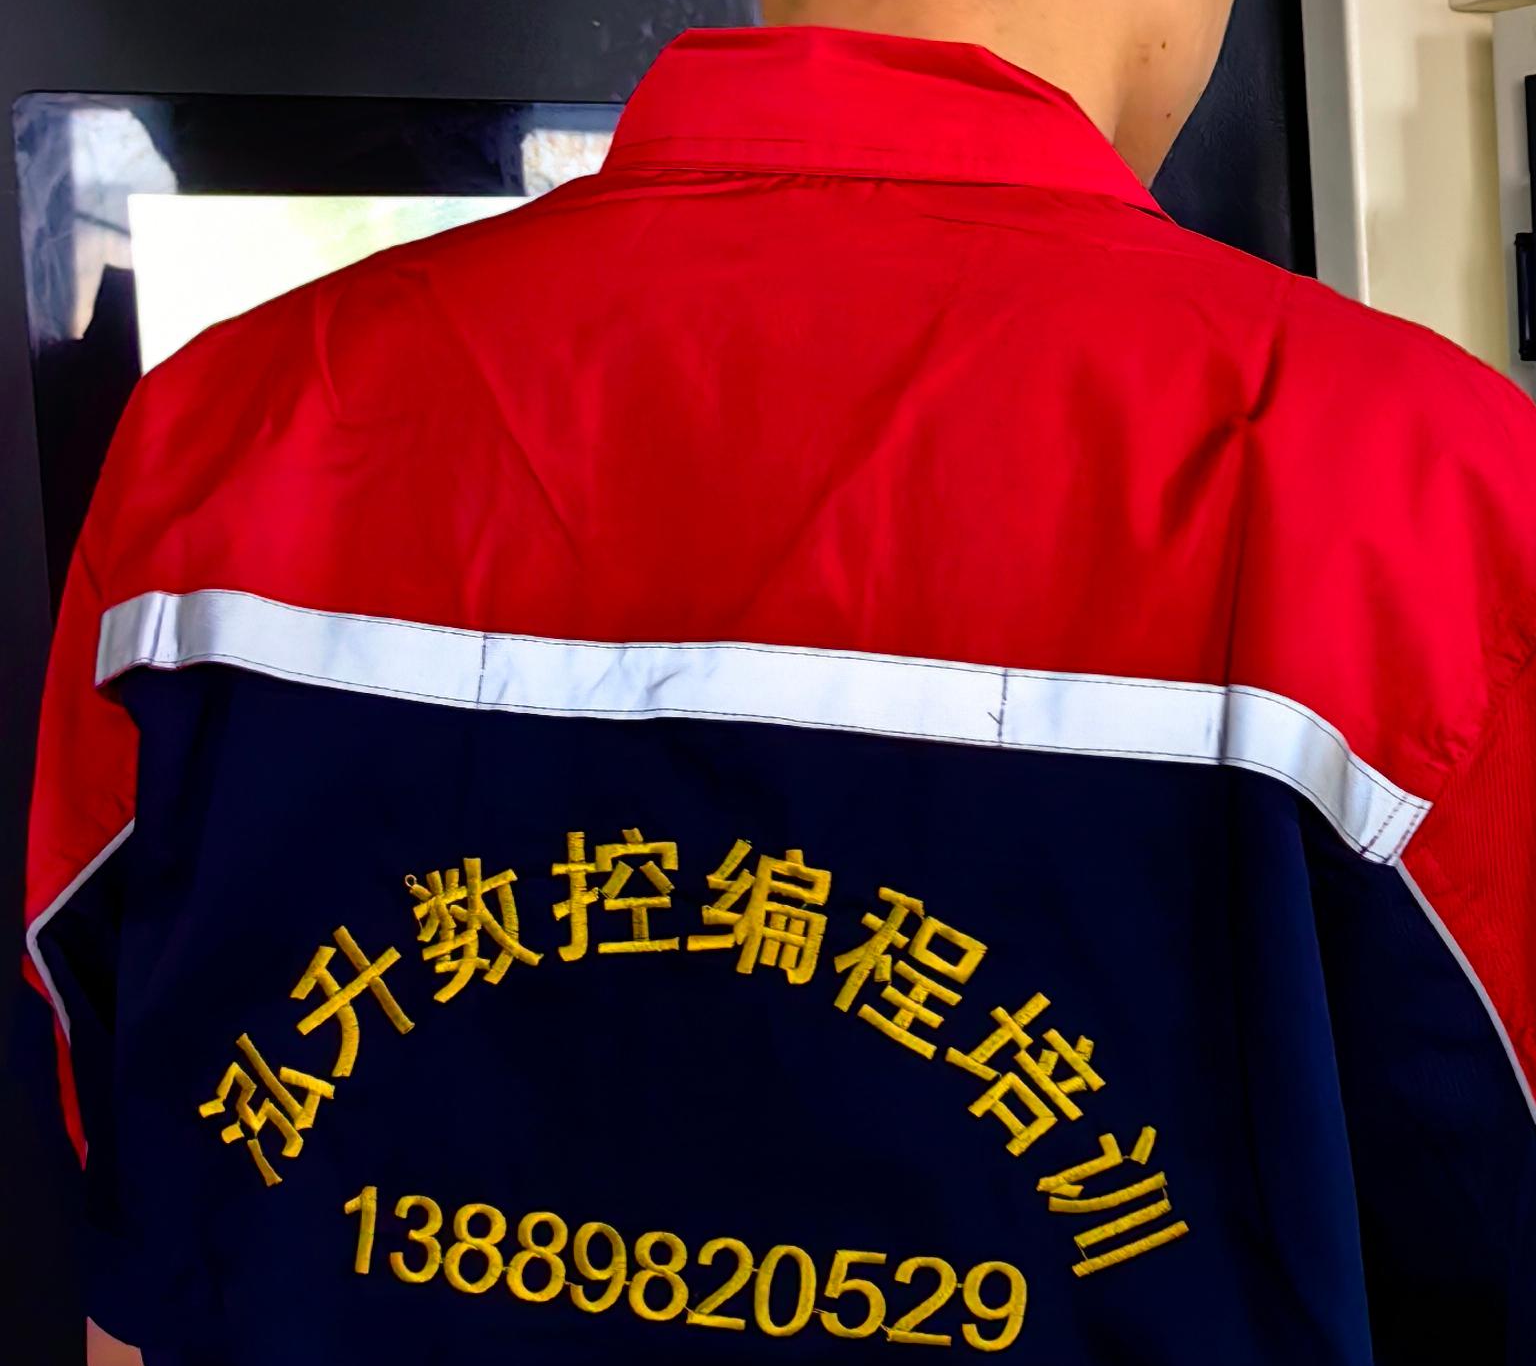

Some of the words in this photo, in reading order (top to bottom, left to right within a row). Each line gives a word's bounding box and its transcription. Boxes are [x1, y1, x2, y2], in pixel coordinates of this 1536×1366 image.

[198, 827, 1190, 1278] 泓升数控编程培训
[343, 1185, 1029, 1352] 13889820529
